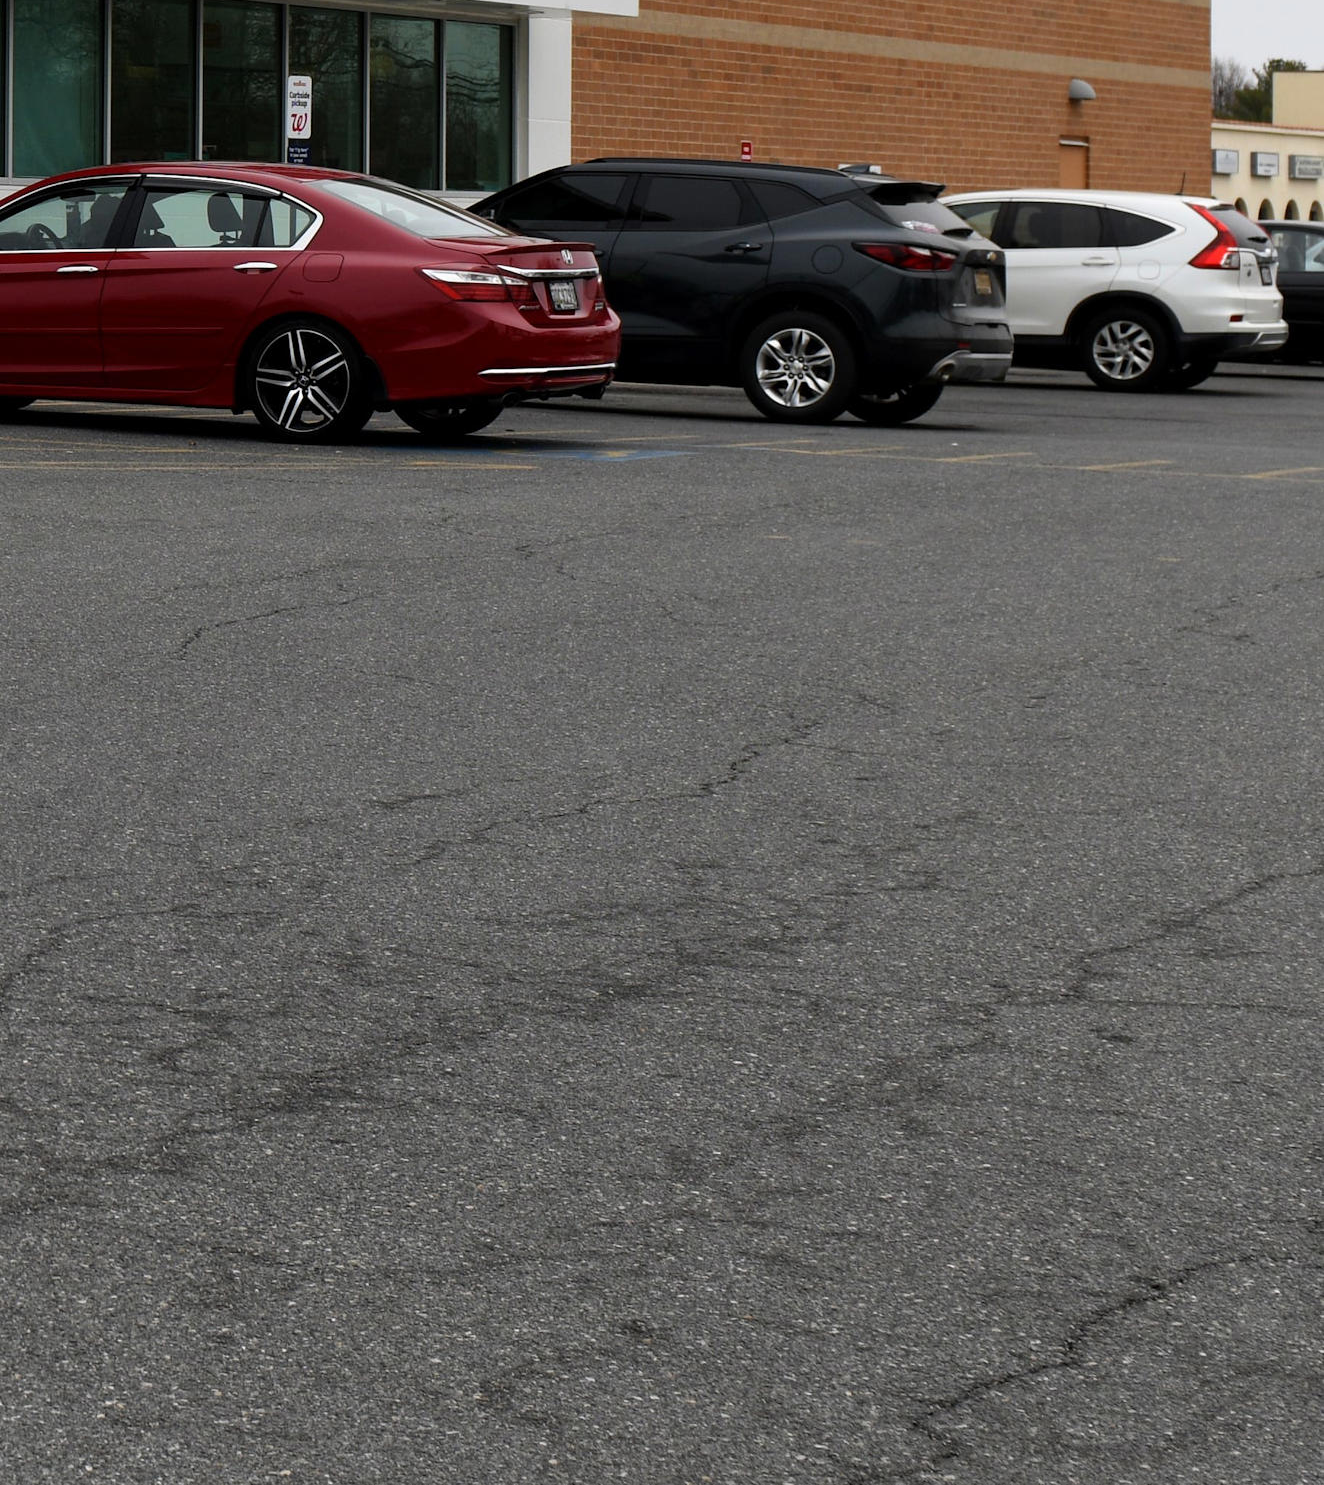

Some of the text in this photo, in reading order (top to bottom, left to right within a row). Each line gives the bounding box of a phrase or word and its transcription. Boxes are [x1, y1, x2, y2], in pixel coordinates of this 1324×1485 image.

[289, 91, 310, 99] Curbside
[291, 100, 308, 108] pickup
[291, 113, 308, 132] W
